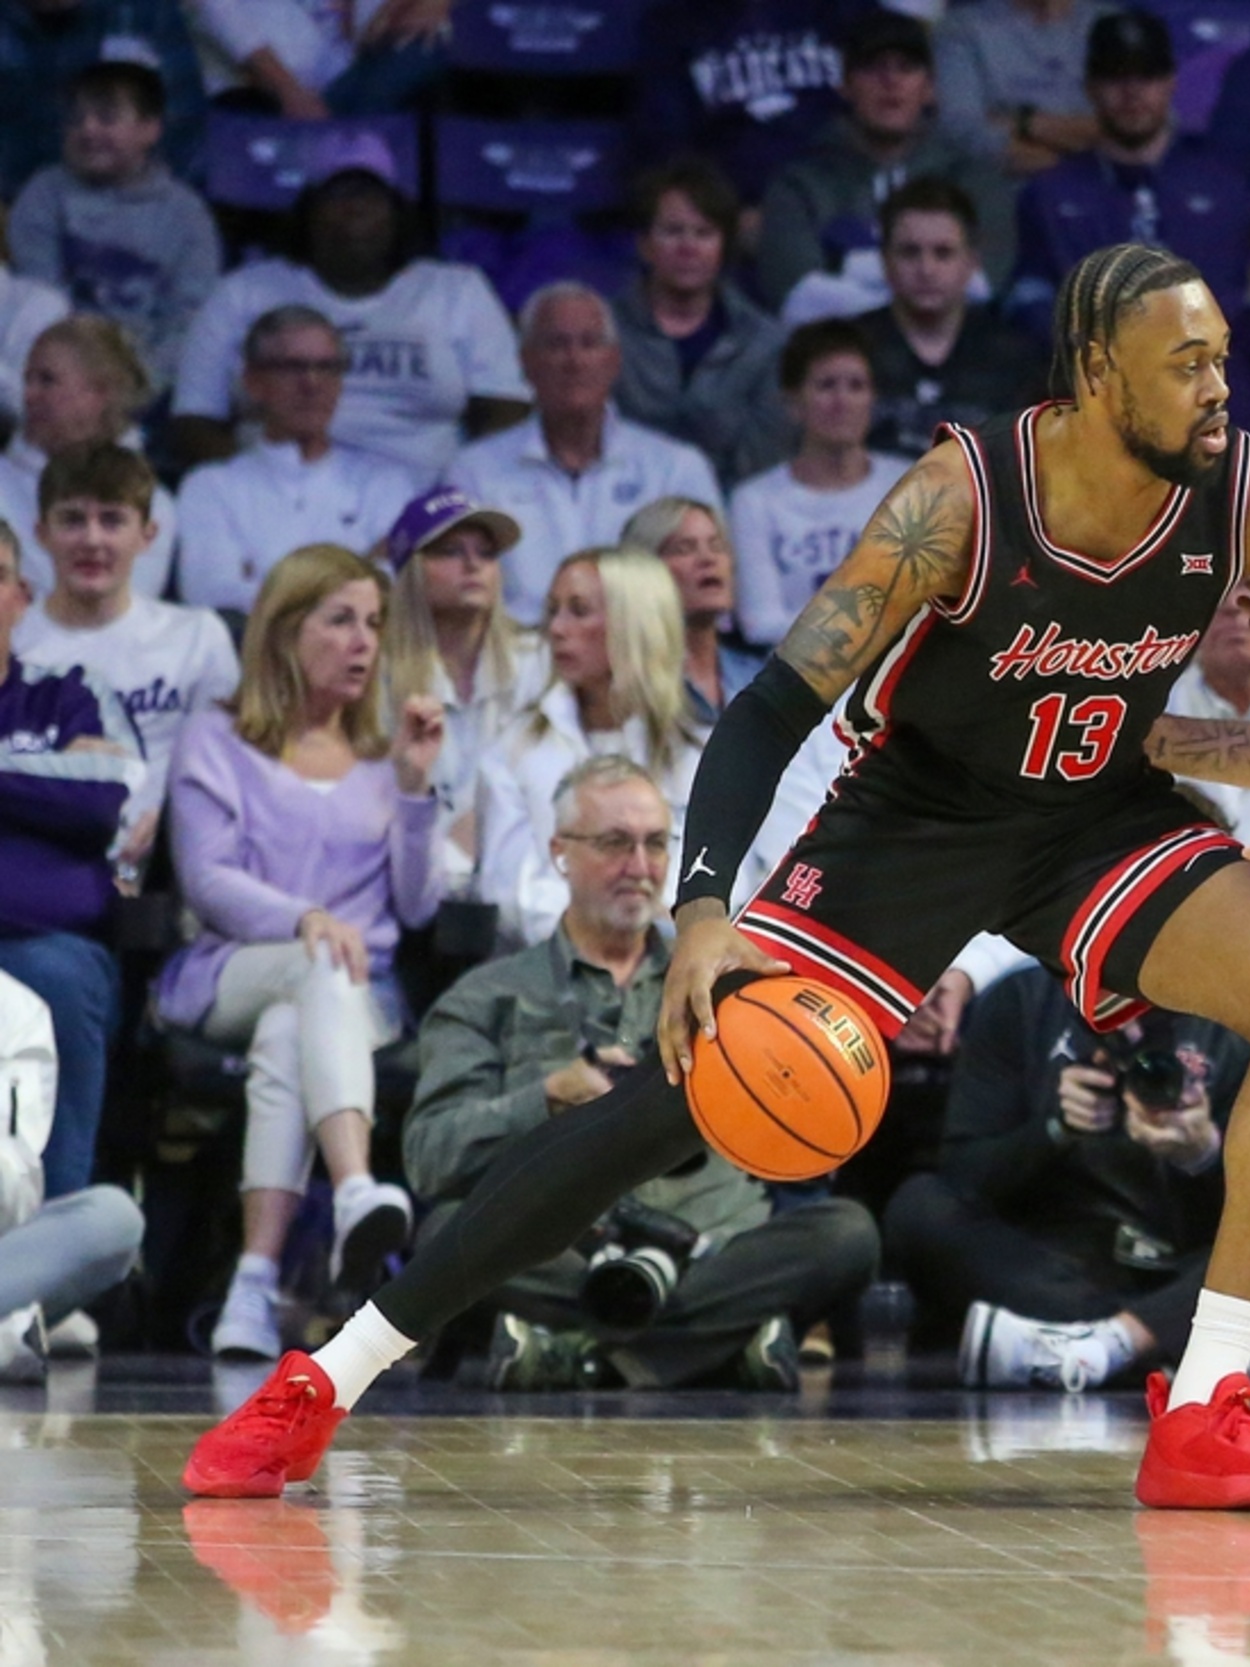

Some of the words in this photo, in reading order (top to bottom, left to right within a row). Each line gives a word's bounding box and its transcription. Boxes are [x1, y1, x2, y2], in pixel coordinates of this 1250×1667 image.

[990, 621, 1200, 681] Houston
[1020, 693, 1127, 782] 13
[792, 988, 876, 1076] ELITE
